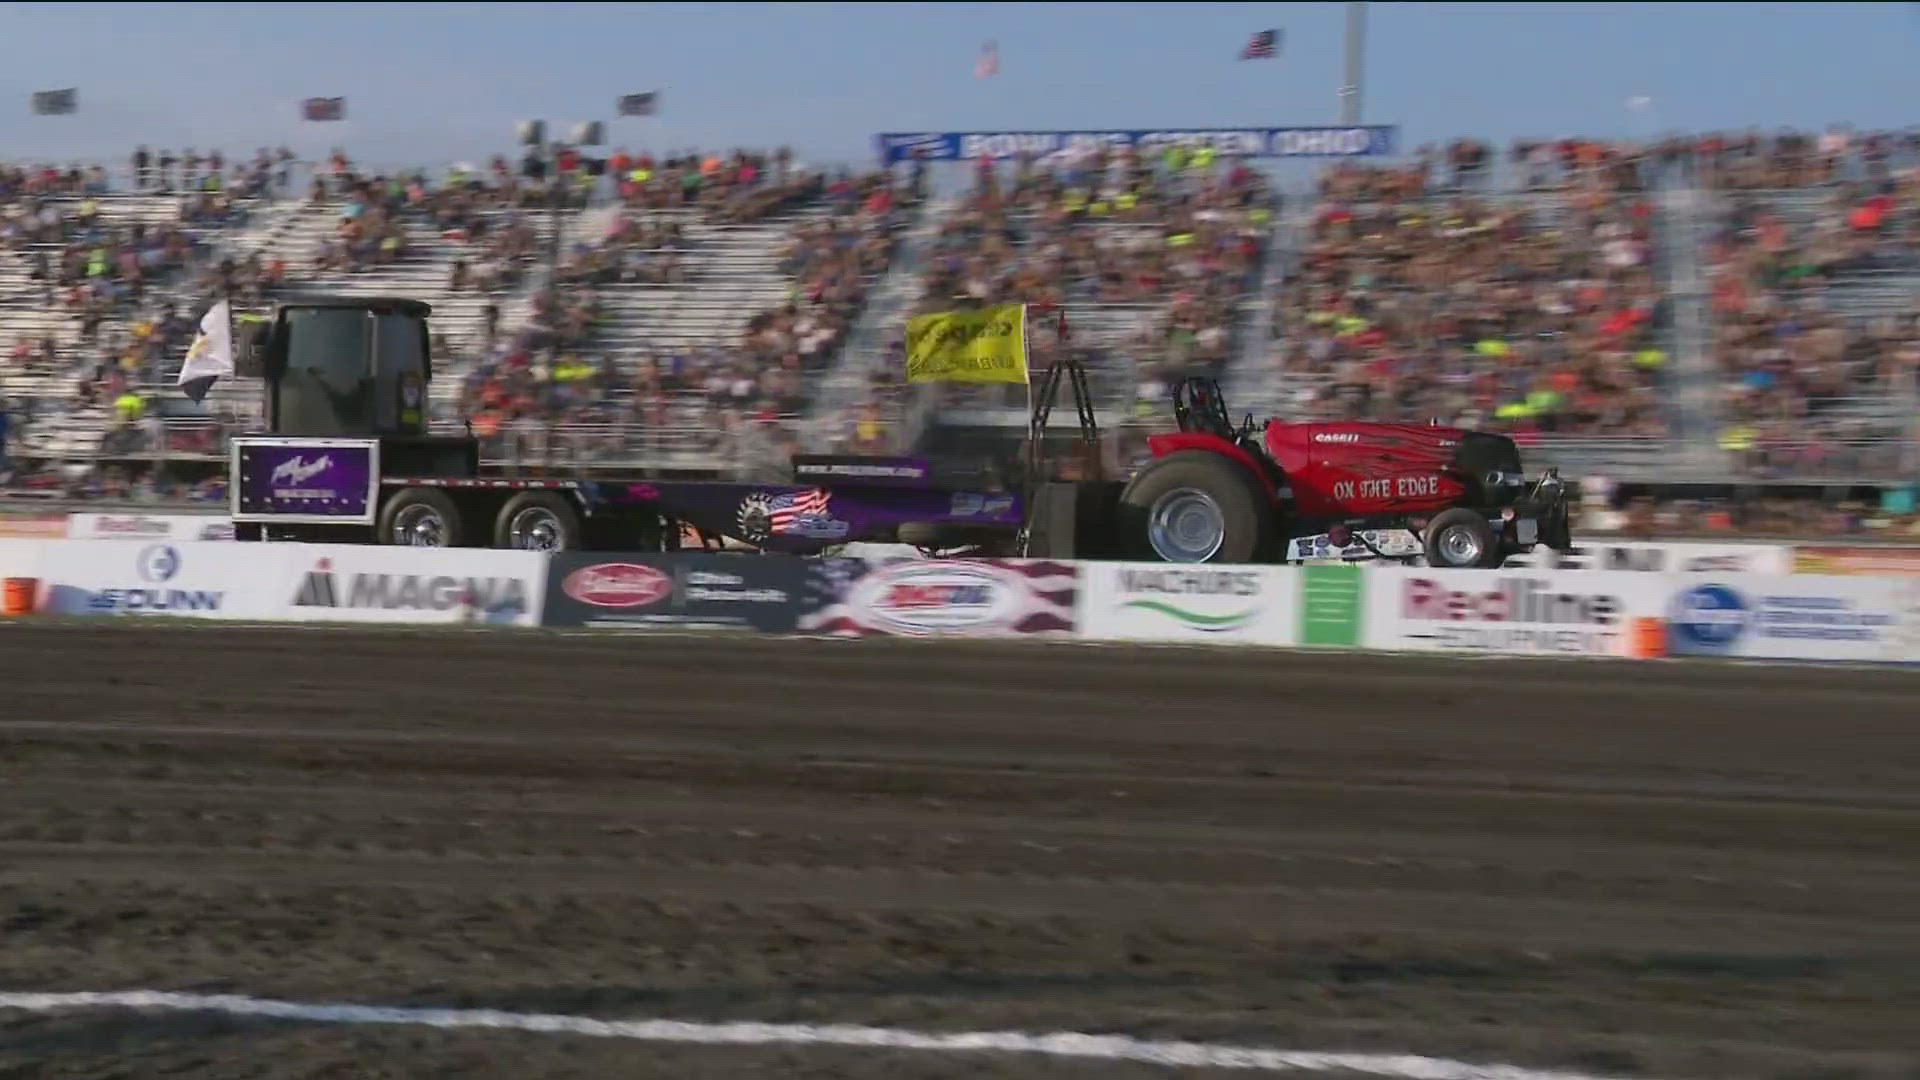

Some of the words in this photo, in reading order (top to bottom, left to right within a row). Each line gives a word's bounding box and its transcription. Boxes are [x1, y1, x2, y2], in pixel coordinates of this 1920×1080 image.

[1333, 479, 1355, 500] ON
[1360, 478, 1391, 498] THE
[1397, 476, 1439, 496] EDGE
[348, 572, 527, 611] MAGNA
[1402, 577, 1624, 624] Redline
